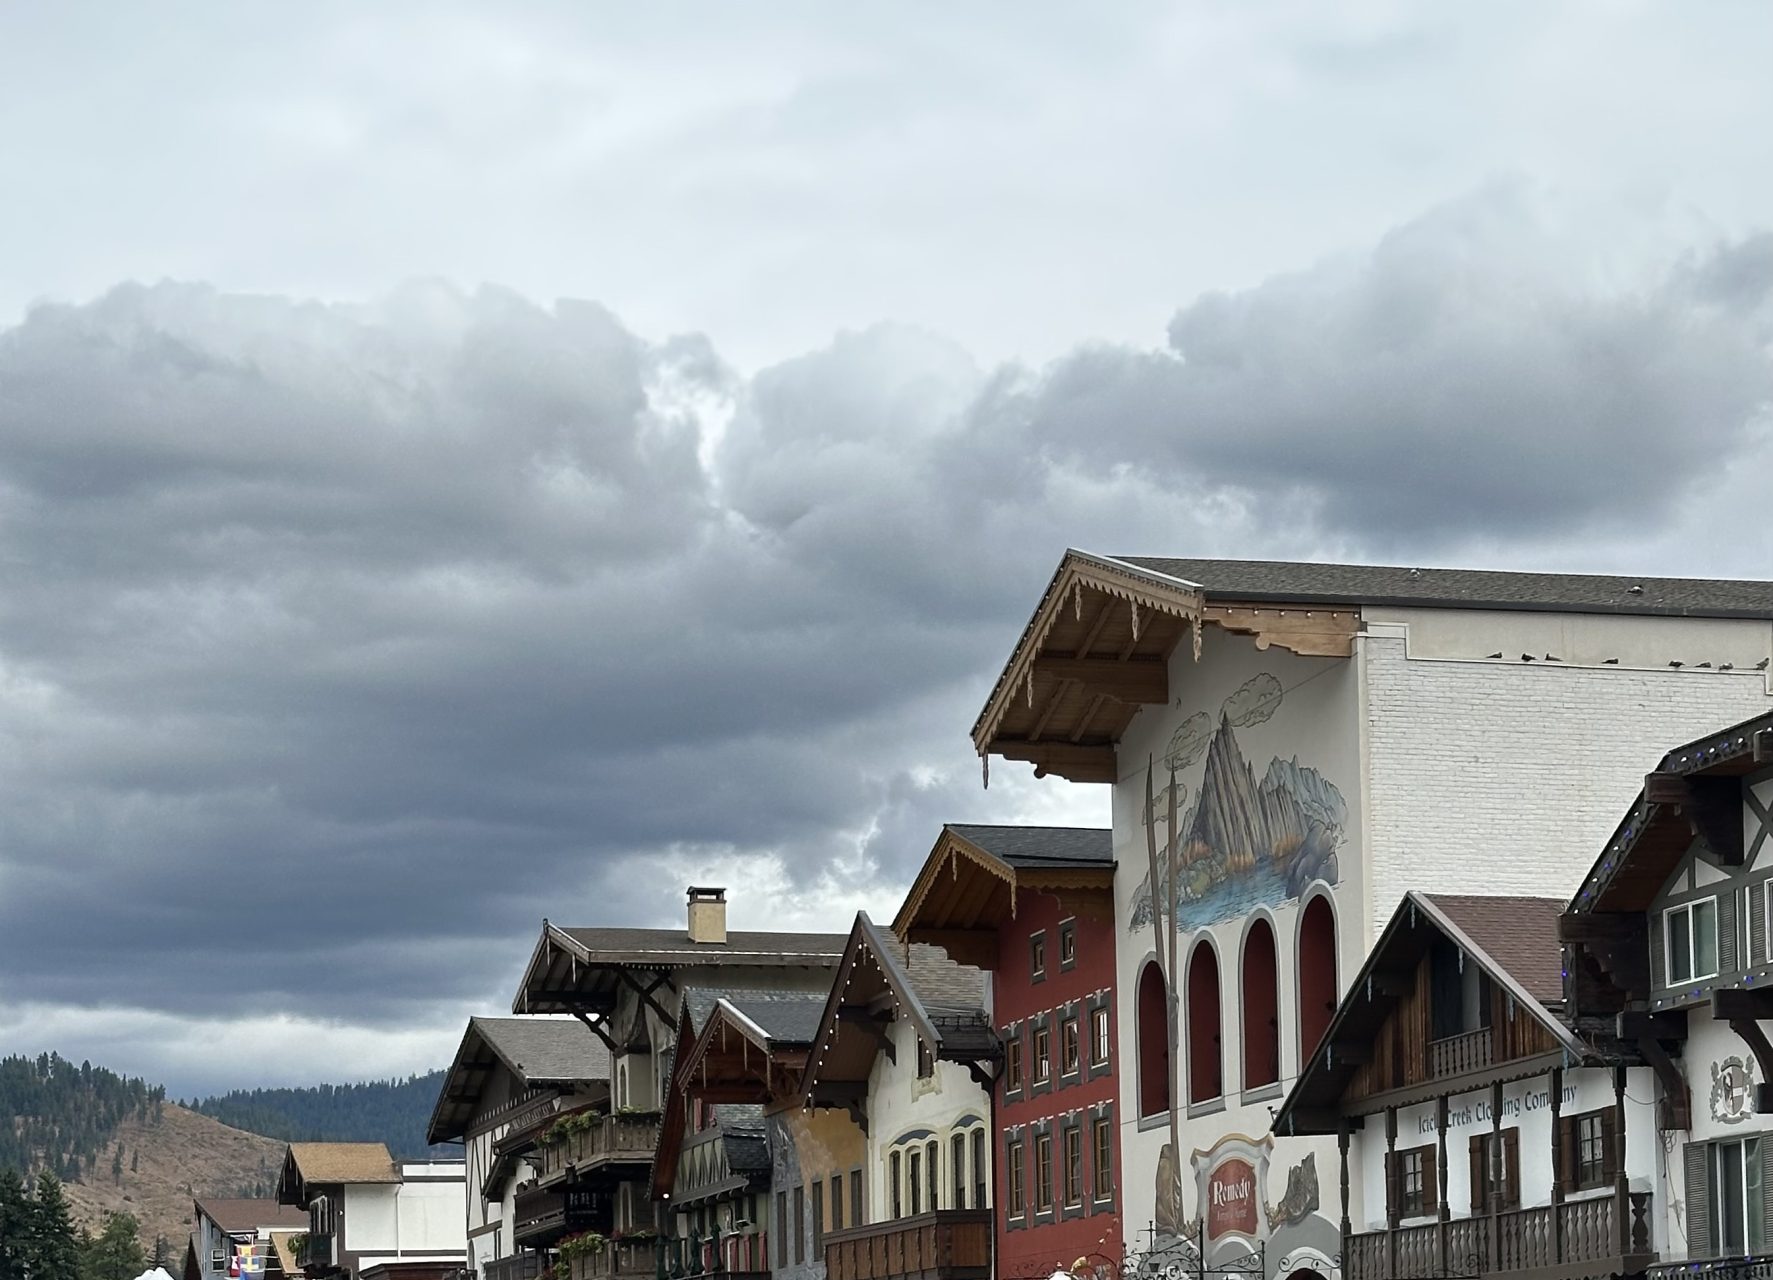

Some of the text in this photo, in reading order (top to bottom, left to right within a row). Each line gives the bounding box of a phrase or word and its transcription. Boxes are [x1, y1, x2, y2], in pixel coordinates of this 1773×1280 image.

[1418, 1112, 1438, 1135] Icicl
[1475, 1096, 1521, 1123] Cloing
[1524, 1084, 1577, 1112] Comny
[1213, 1177, 1251, 1207] Remedy
